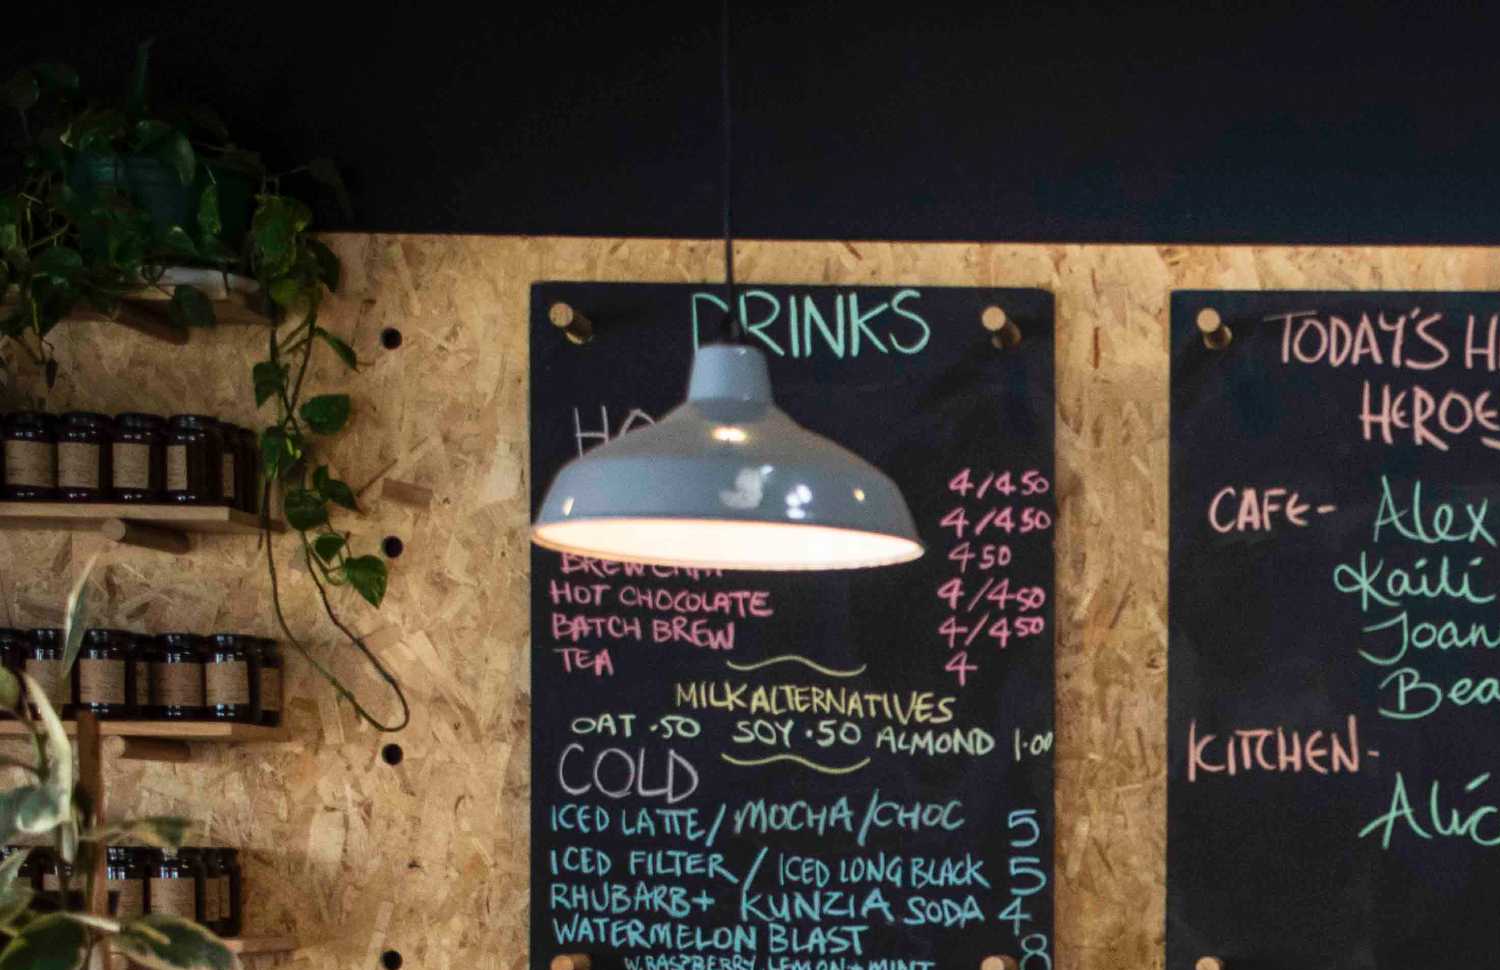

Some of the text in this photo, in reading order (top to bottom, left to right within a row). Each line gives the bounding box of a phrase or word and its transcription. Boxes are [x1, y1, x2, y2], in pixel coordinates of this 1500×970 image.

[692, 290, 930, 358] DRINKS
[1263, 307, 1451, 370] TODAY'S
[1373, 474, 1498, 547] Alex
[551, 579, 612, 606] HOT
[618, 585, 774, 618] CHOCOLATE
[552, 612, 642, 642] BATCH
[652, 615, 735, 650] BREW
[553, 648, 978, 686] TEA 4
[571, 714, 637, 738] OAT
[732, 719, 794, 748] SOY
[876, 725, 995, 757] ALMOND
[559, 743, 699, 804] COLD
[551, 803, 610, 834] ICED
[1008, 808, 1041, 848] 5
[551, 845, 612, 876] ICED
[778, 851, 831, 888] ICED
[839, 851, 902, 888] LONG
[911, 852, 991, 890] BLACK
[1009, 856, 1047, 896] 5
[552, 914, 757, 953] WATERMELON
[768, 924, 869, 956] BLAST
[739, 887, 896, 924] KUNZIA
[903, 894, 985, 929] SODA
[997, 896, 1032, 937] 4
